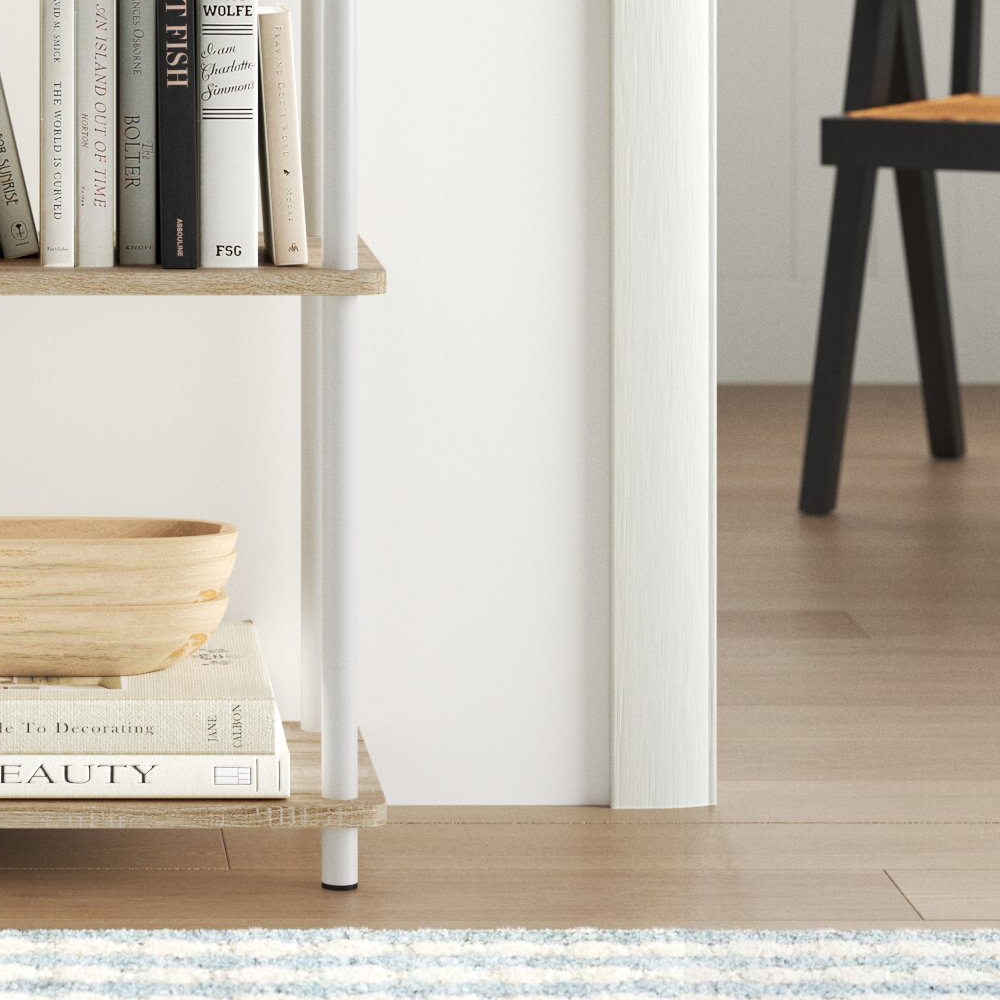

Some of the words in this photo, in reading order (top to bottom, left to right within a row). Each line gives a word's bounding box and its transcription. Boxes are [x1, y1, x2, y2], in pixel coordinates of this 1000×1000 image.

[202, 5, 254, 17] WOLFE
[94, 36, 107, 97] ISLAND
[132, 28, 145, 76] OSBORNE
[165, 23, 189, 88] FISH
[200, 59, 256, 81] Charlotte
[53, 81, 62, 105] THE
[53, 109, 62, 153] WORLD
[81, 113, 89, 149] HORTON
[94, 101, 107, 136] OUT
[53, 157, 62, 167] IS
[94, 140, 107, 163] OF
[124, 115, 141, 189] BOLTER
[53, 171, 62, 220] CURVED
[94, 168, 107, 208] TIME
[215, 244, 243, 257] FSG
[21, 722, 47, 734] To
[56, 722, 155, 735] Decorating
[207, 715, 218, 742] JANE
[232, 704, 242, 748] CALBON
